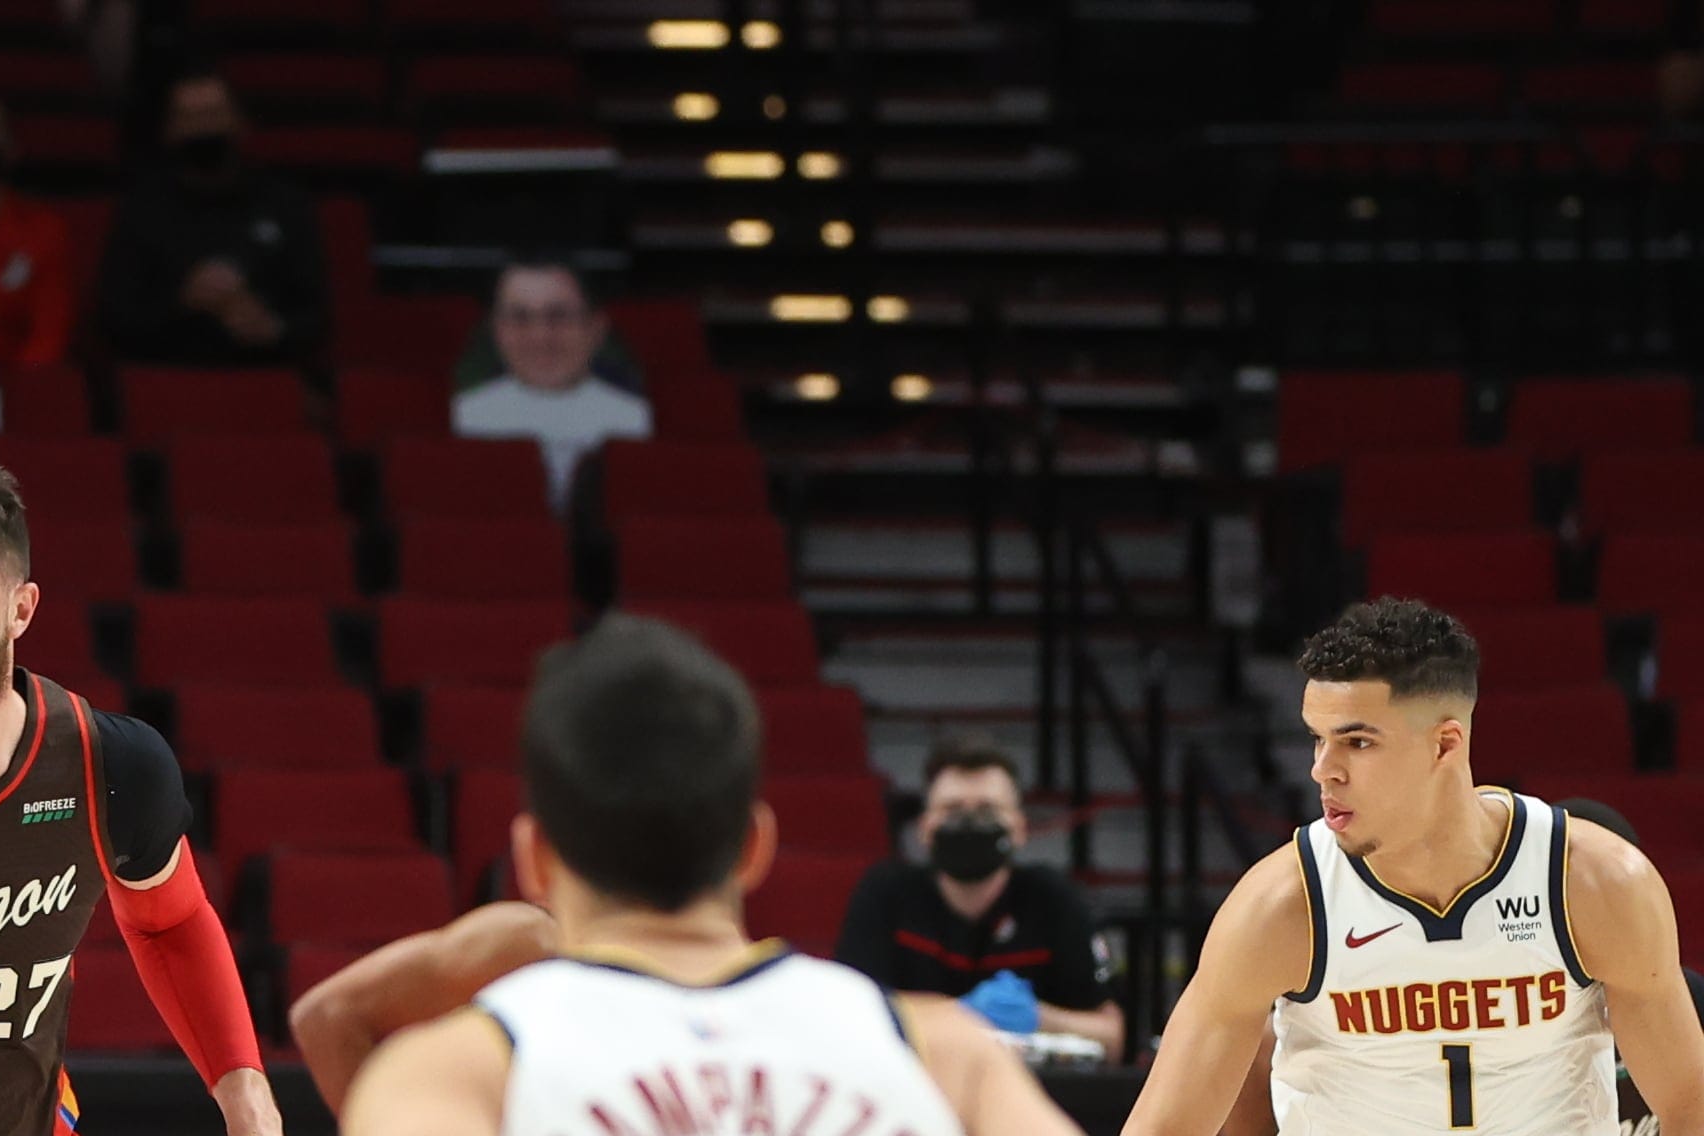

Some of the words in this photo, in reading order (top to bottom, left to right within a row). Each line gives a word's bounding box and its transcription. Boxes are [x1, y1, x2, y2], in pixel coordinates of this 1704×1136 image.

[1495, 895, 1540, 919] WU
[1498, 921, 1542, 932] Western
[1507, 931, 1536, 942] Union
[1328, 969, 1567, 1035] NUGGETS
[1439, 1042, 1478, 1131] 1
